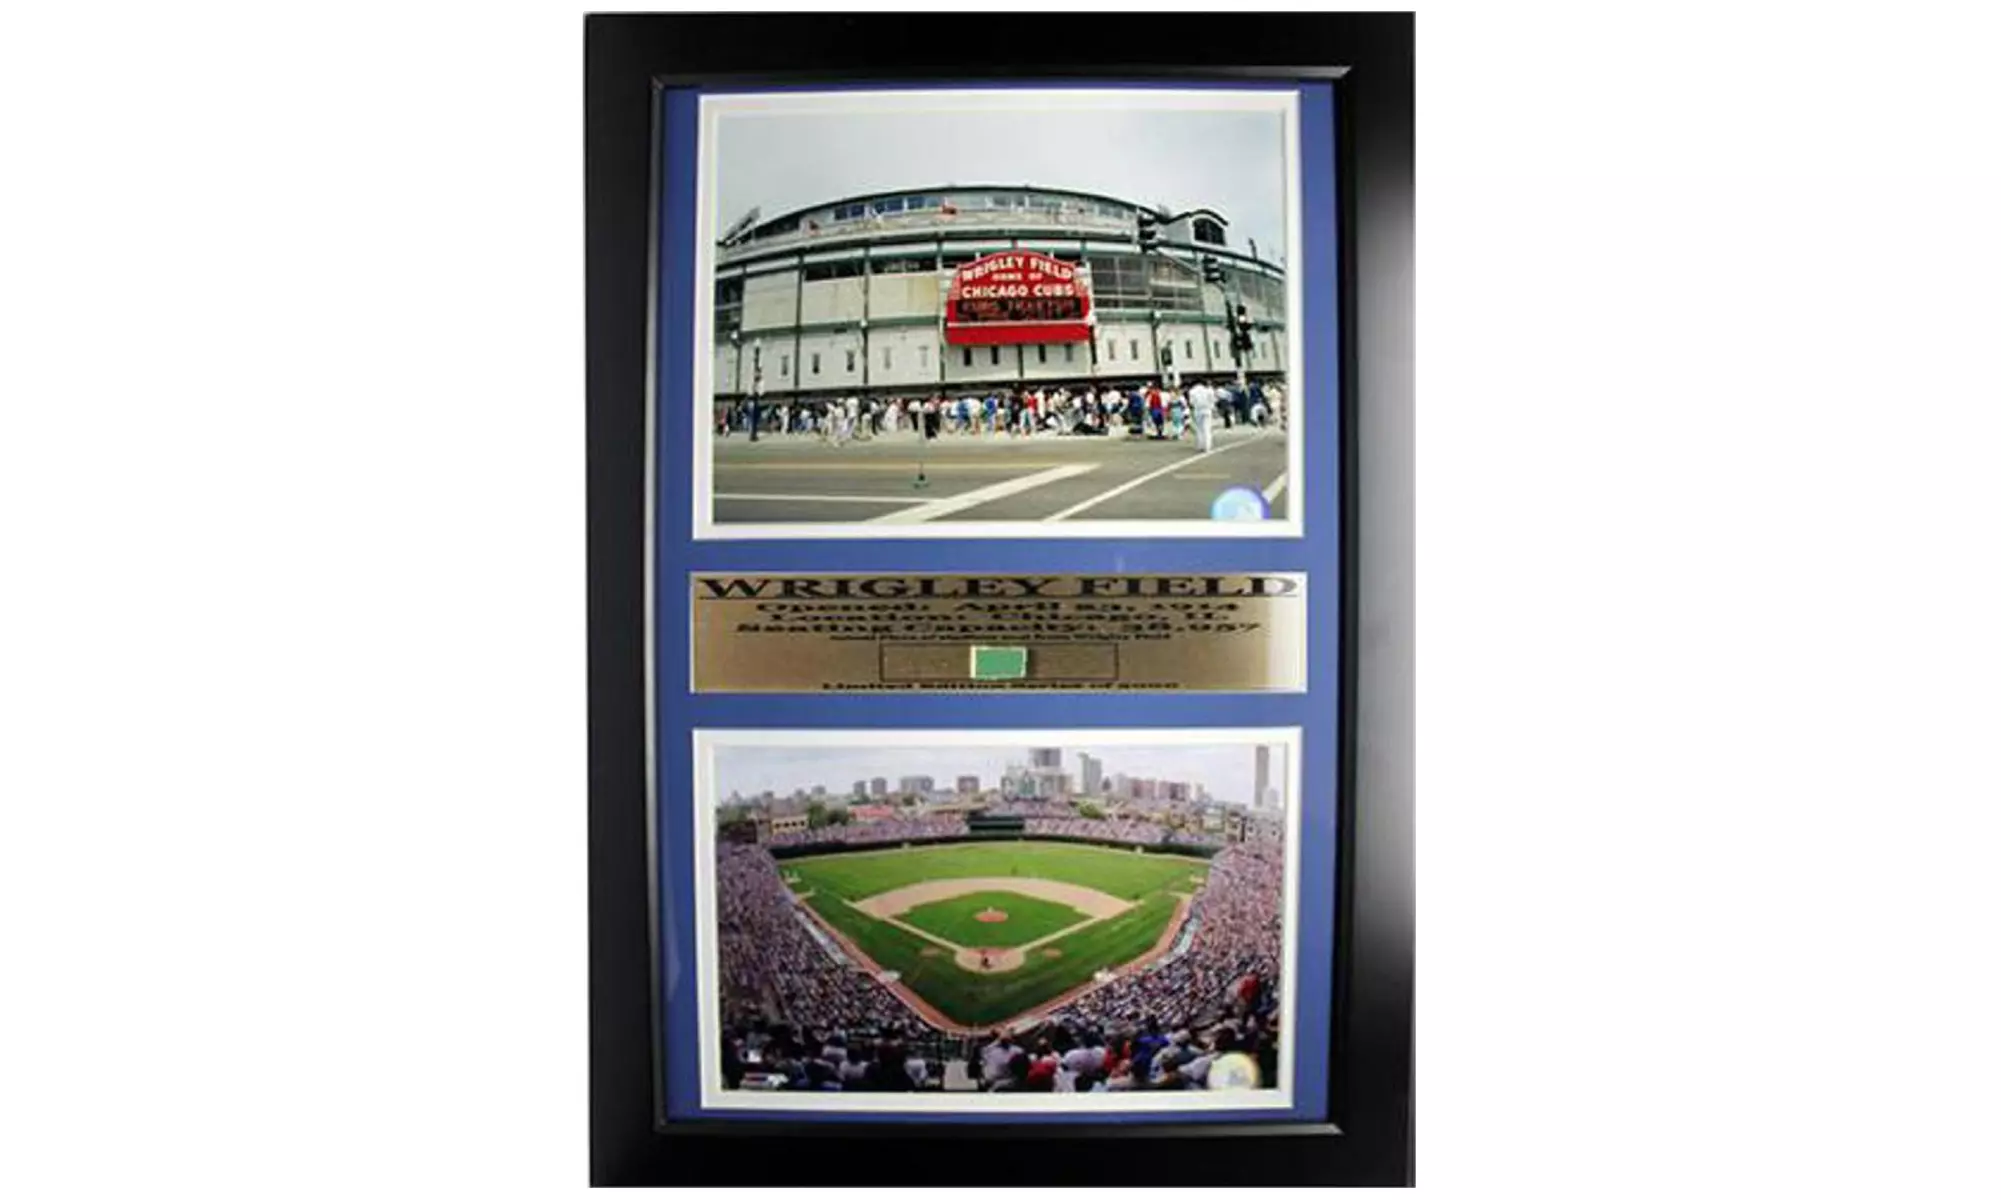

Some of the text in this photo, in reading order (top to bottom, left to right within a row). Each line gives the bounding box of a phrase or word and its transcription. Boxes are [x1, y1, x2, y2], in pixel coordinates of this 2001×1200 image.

[962, 256, 1073, 281] WRIGLEY FIELD
[962, 283, 1074, 299] CHICAGO CUBS
[702, 576, 1298, 598] WRIGLEY FIELD
[756, 603, 930, 612] Opened:
[954, 602, 1061, 612] April
[769, 613, 966, 622] Location:
[737, 623, 893, 633] Seating
